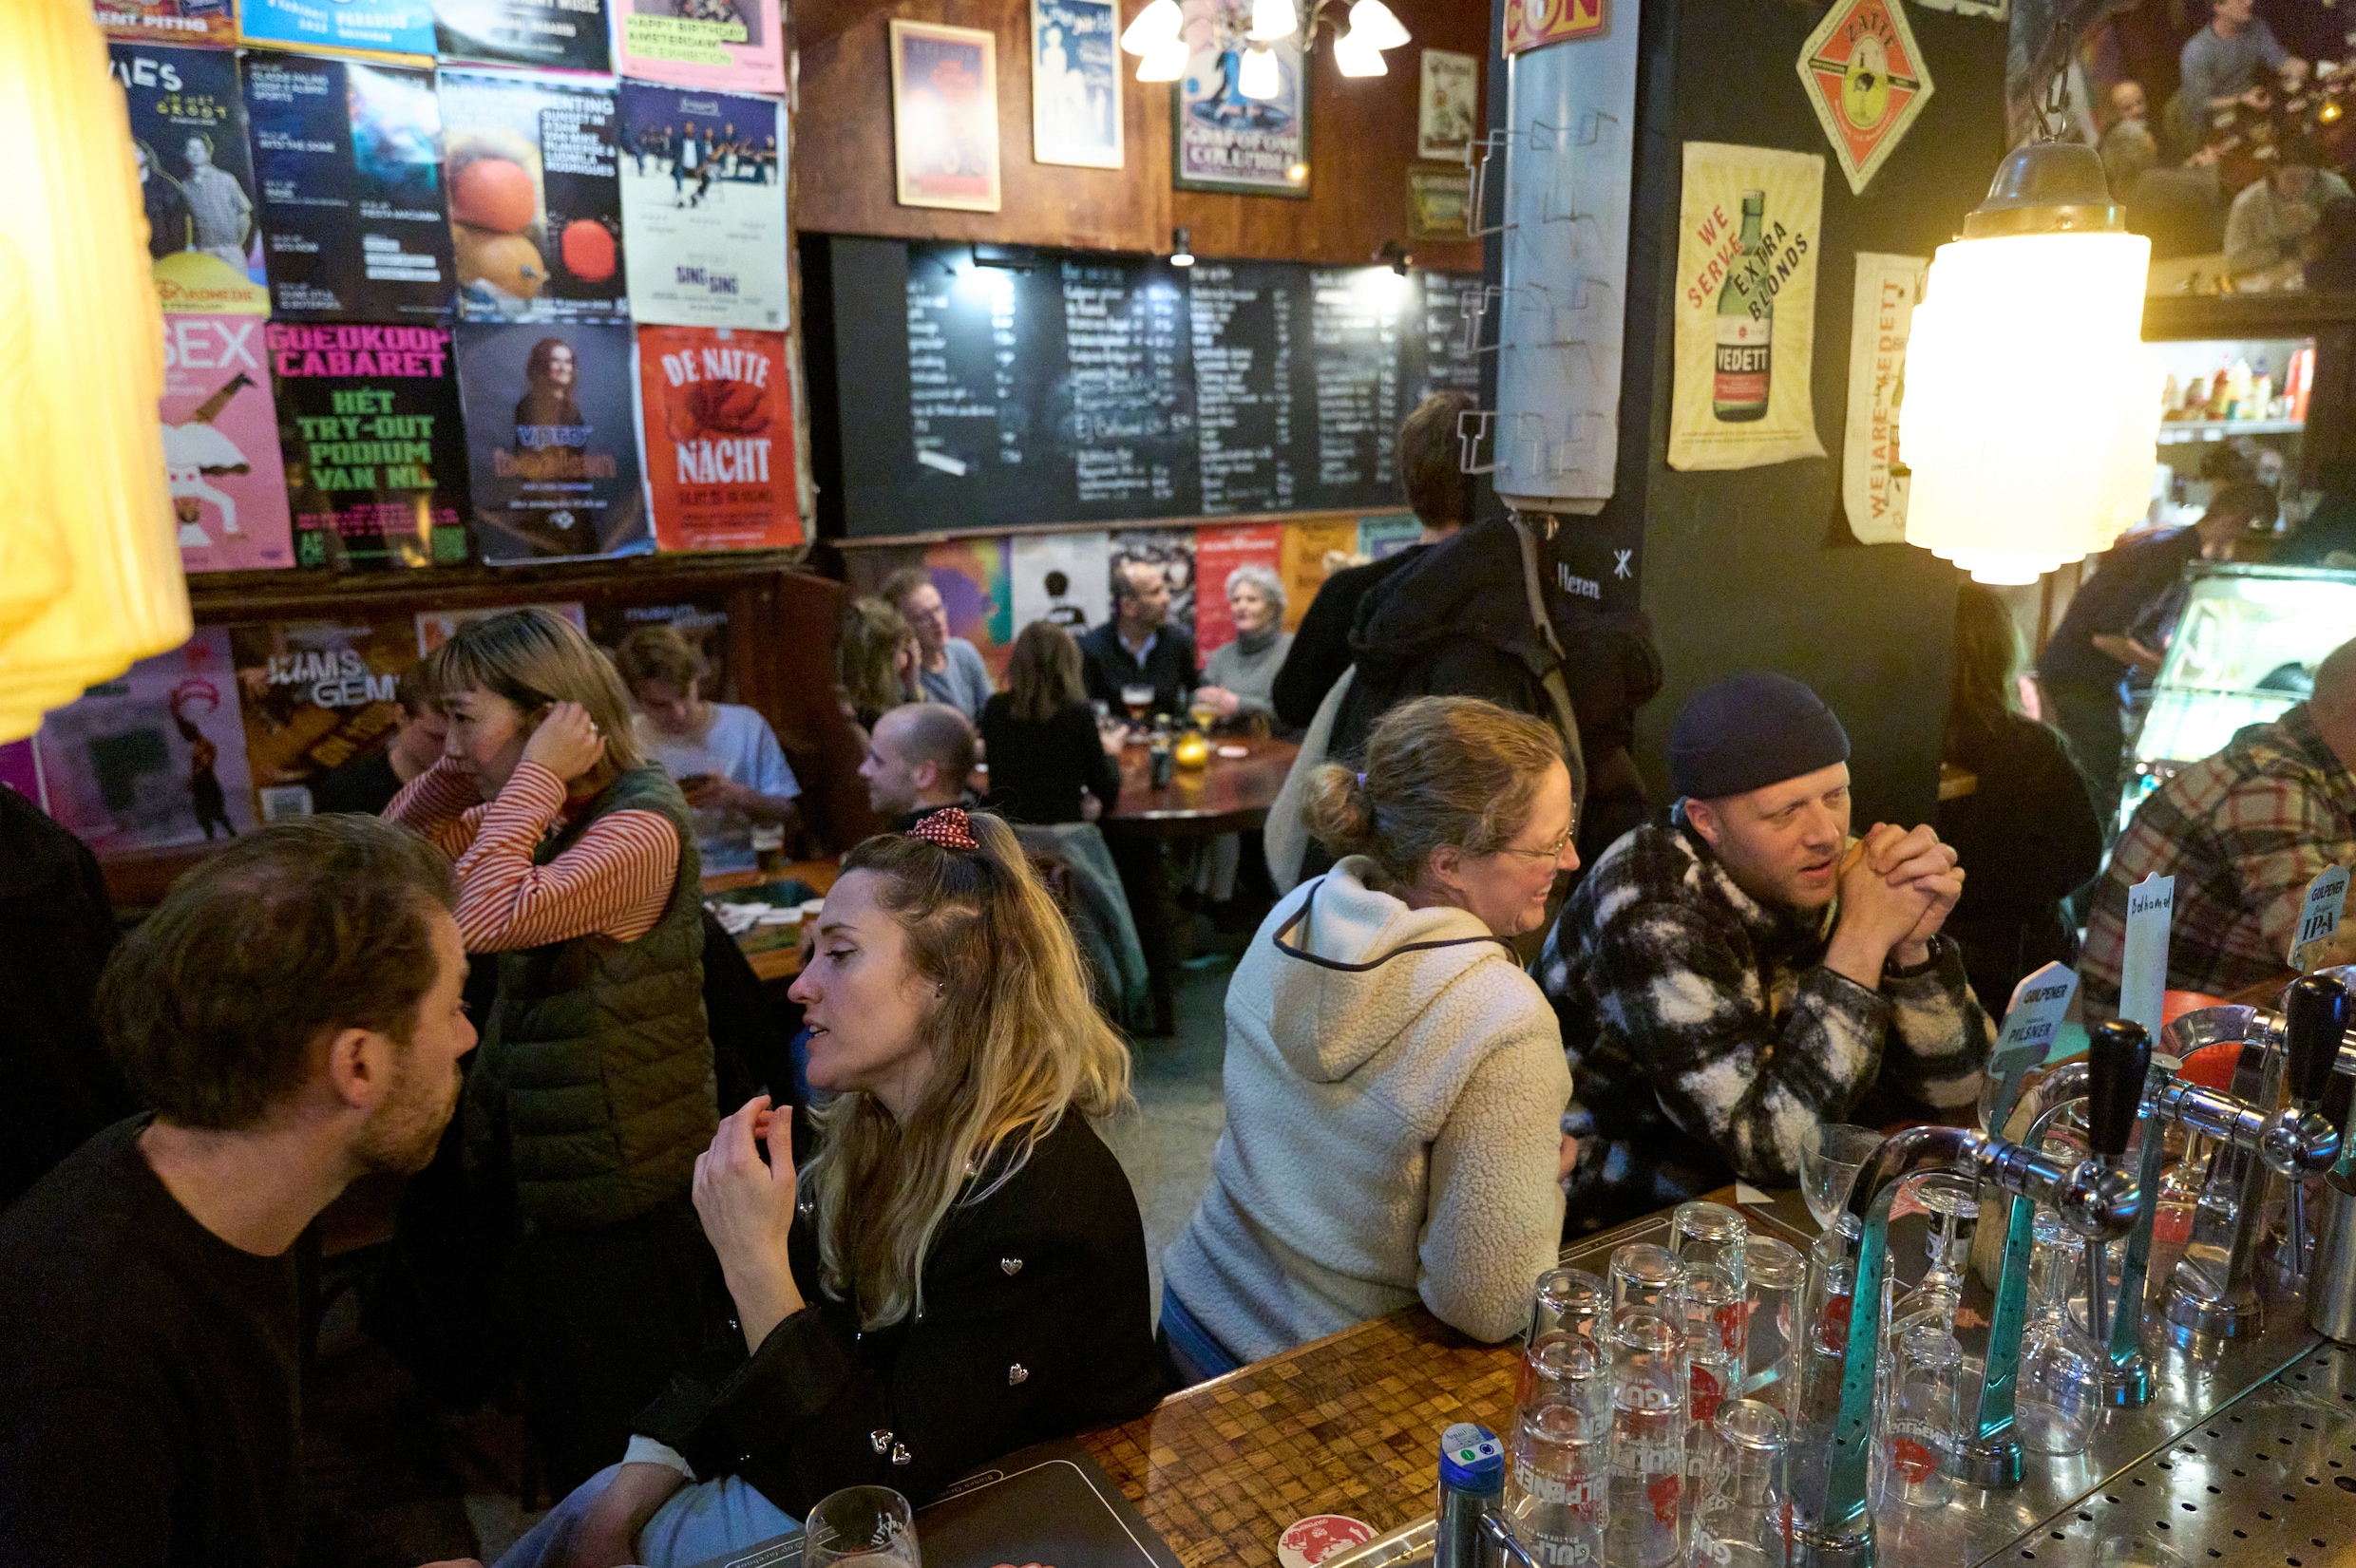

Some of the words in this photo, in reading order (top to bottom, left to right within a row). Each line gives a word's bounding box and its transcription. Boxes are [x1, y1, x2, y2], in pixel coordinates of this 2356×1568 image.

[626, 18, 674, 28] HAPPY
[677, 22, 745, 38] BIRTHDAY
[628, 31, 719, 48] AMSTERDAM
[1846, 12, 1894, 51] ZATTE
[658, 47, 733, 65] EXHIBITION
[1698, 205, 1728, 247] WE
[1688, 232, 1745, 309] SERVE
[1733, 220, 1787, 296] EXTRA
[676, 266, 707, 286] SING
[709, 276, 739, 294] SING
[1749, 233, 1808, 322] BLONDS
[265, 322, 452, 352] GOEDKOOP
[276, 350, 447, 378] CABARET
[661, 349, 701, 387] DE
[701, 349, 771, 388] NATTE
[1718, 348, 1769, 372] VEDETT
[295, 415, 435, 441] TRY-OUT
[1872, 407, 1889, 463] ARE
[308, 441, 432, 466] PODIUM
[676, 439, 772, 484] NACHT
[311, 465, 377, 491] VAN
[1870, 476, 1887, 520] WE
[2310, 879, 2346, 902] GULPENER
[2302, 912, 2334, 941] IPA
[2023, 984, 2069, 1005] GULPENER
[2007, 1023, 2052, 1044] PILSNER
